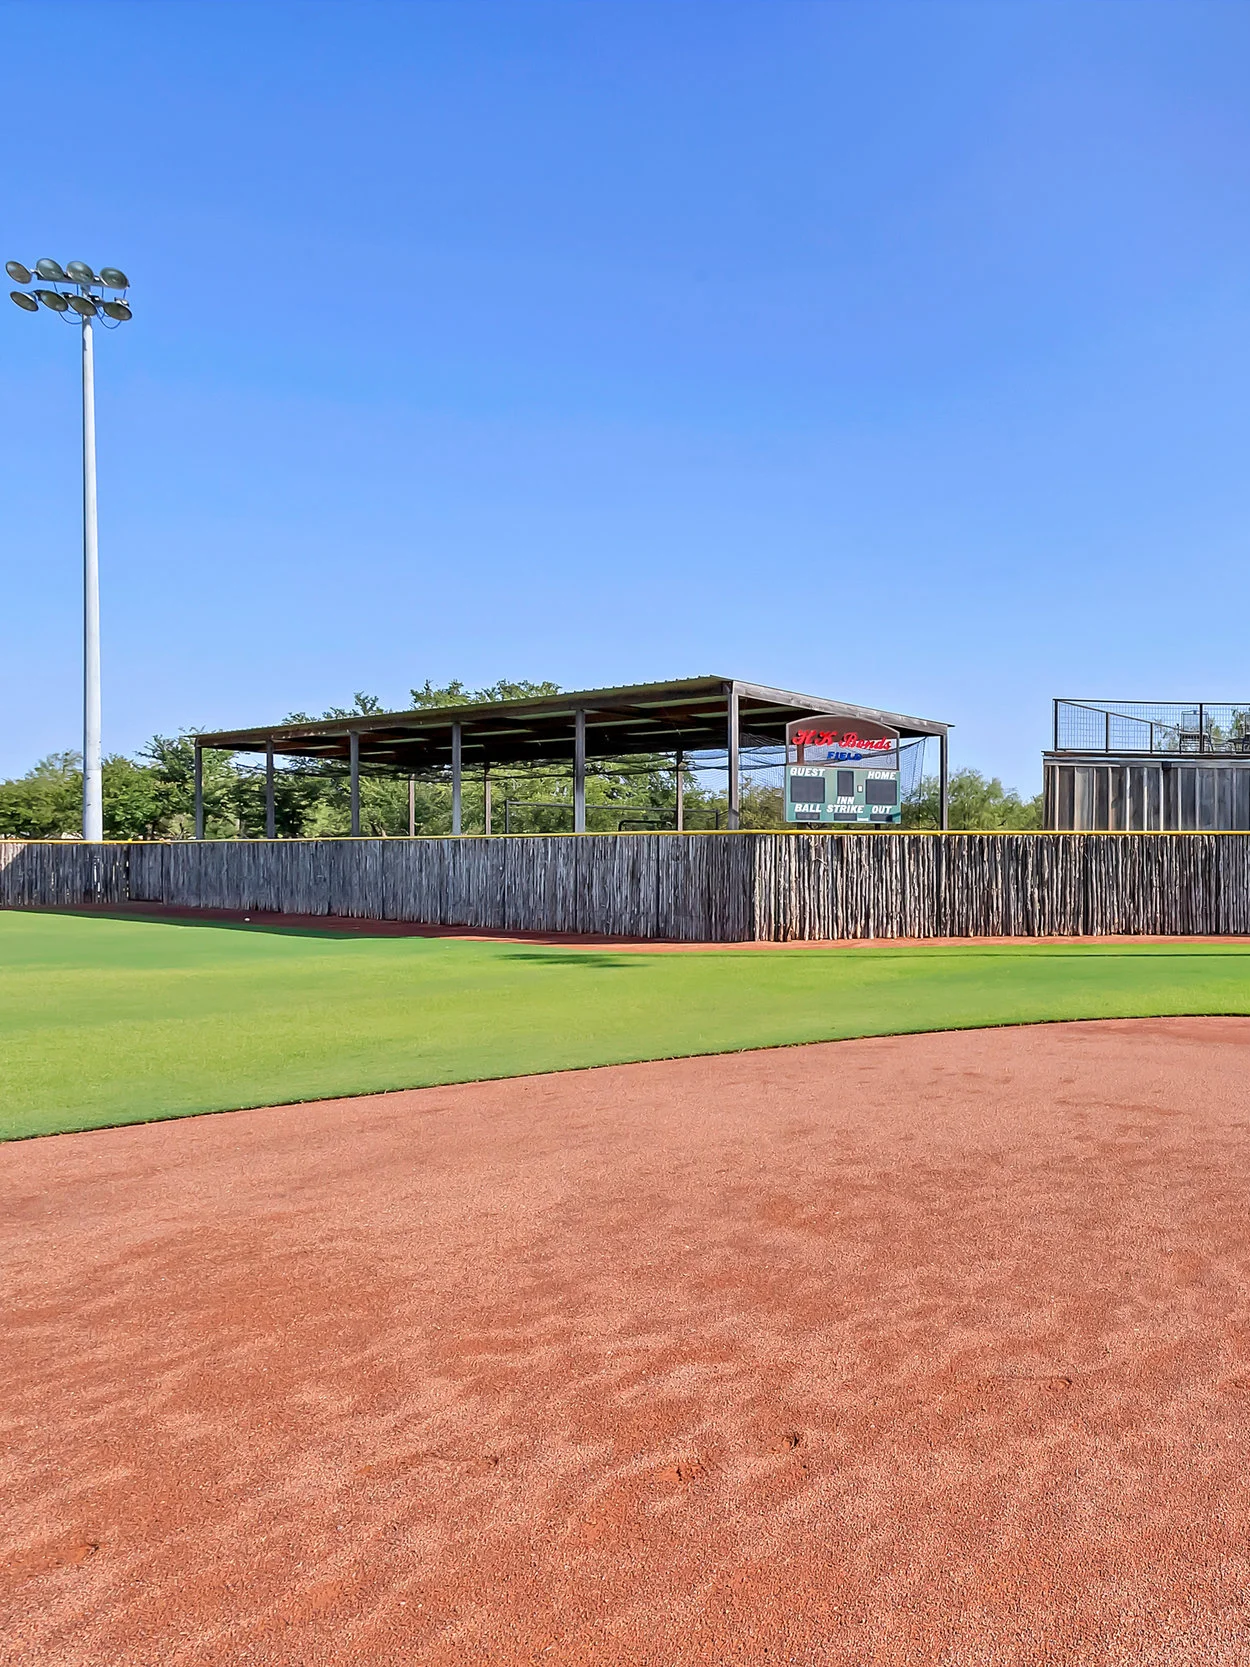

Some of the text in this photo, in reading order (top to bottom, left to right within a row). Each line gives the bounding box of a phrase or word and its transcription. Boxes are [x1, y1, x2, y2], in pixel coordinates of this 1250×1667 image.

[838, 731, 892, 750] Bonds
[827, 751, 863, 760] FIELD
[790, 767, 825, 777] GUEST
[867, 771, 896, 780] HOME
[837, 796, 854, 804] INN
[794, 804, 822, 812] BALL
[826, 805, 864, 813] STRIKE
[871, 805, 892, 814] OUT
